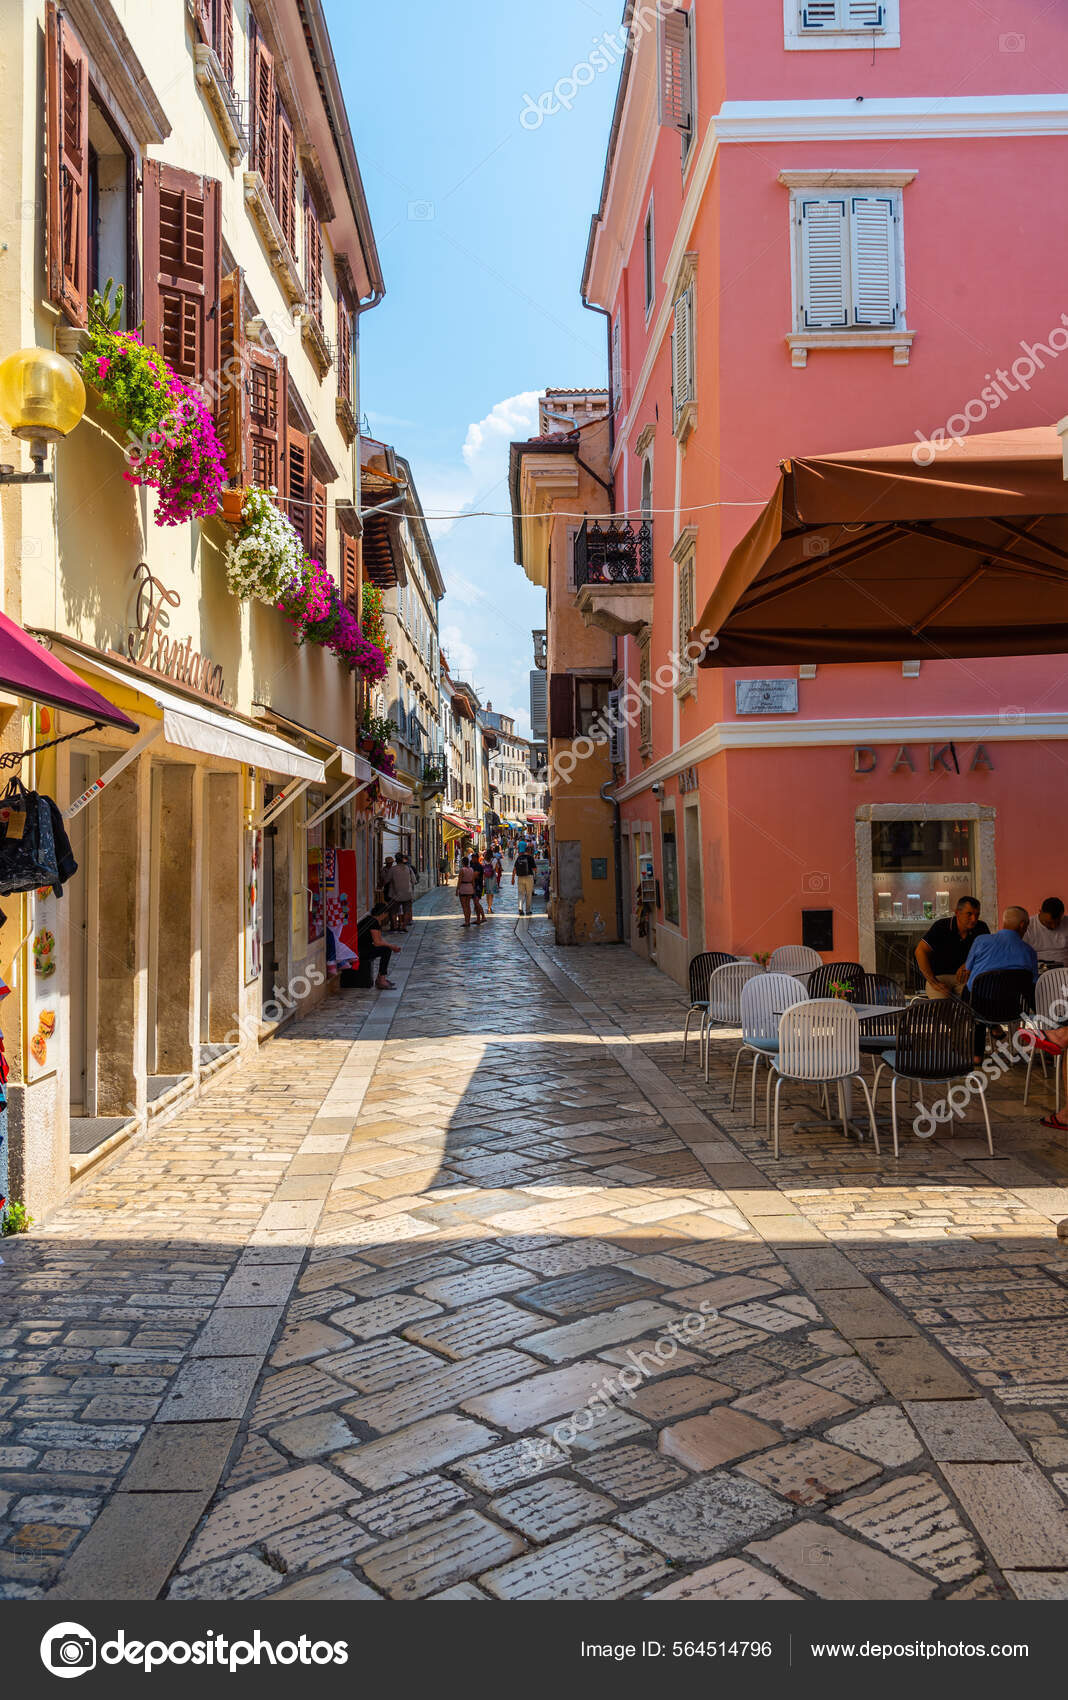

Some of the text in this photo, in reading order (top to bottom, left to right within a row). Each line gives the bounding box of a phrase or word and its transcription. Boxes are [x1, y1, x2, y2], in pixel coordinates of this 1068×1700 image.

[128, 562, 225, 699] Fontana
[854, 744, 995, 773] DAKA
[943, 875, 969, 883] DAKA
